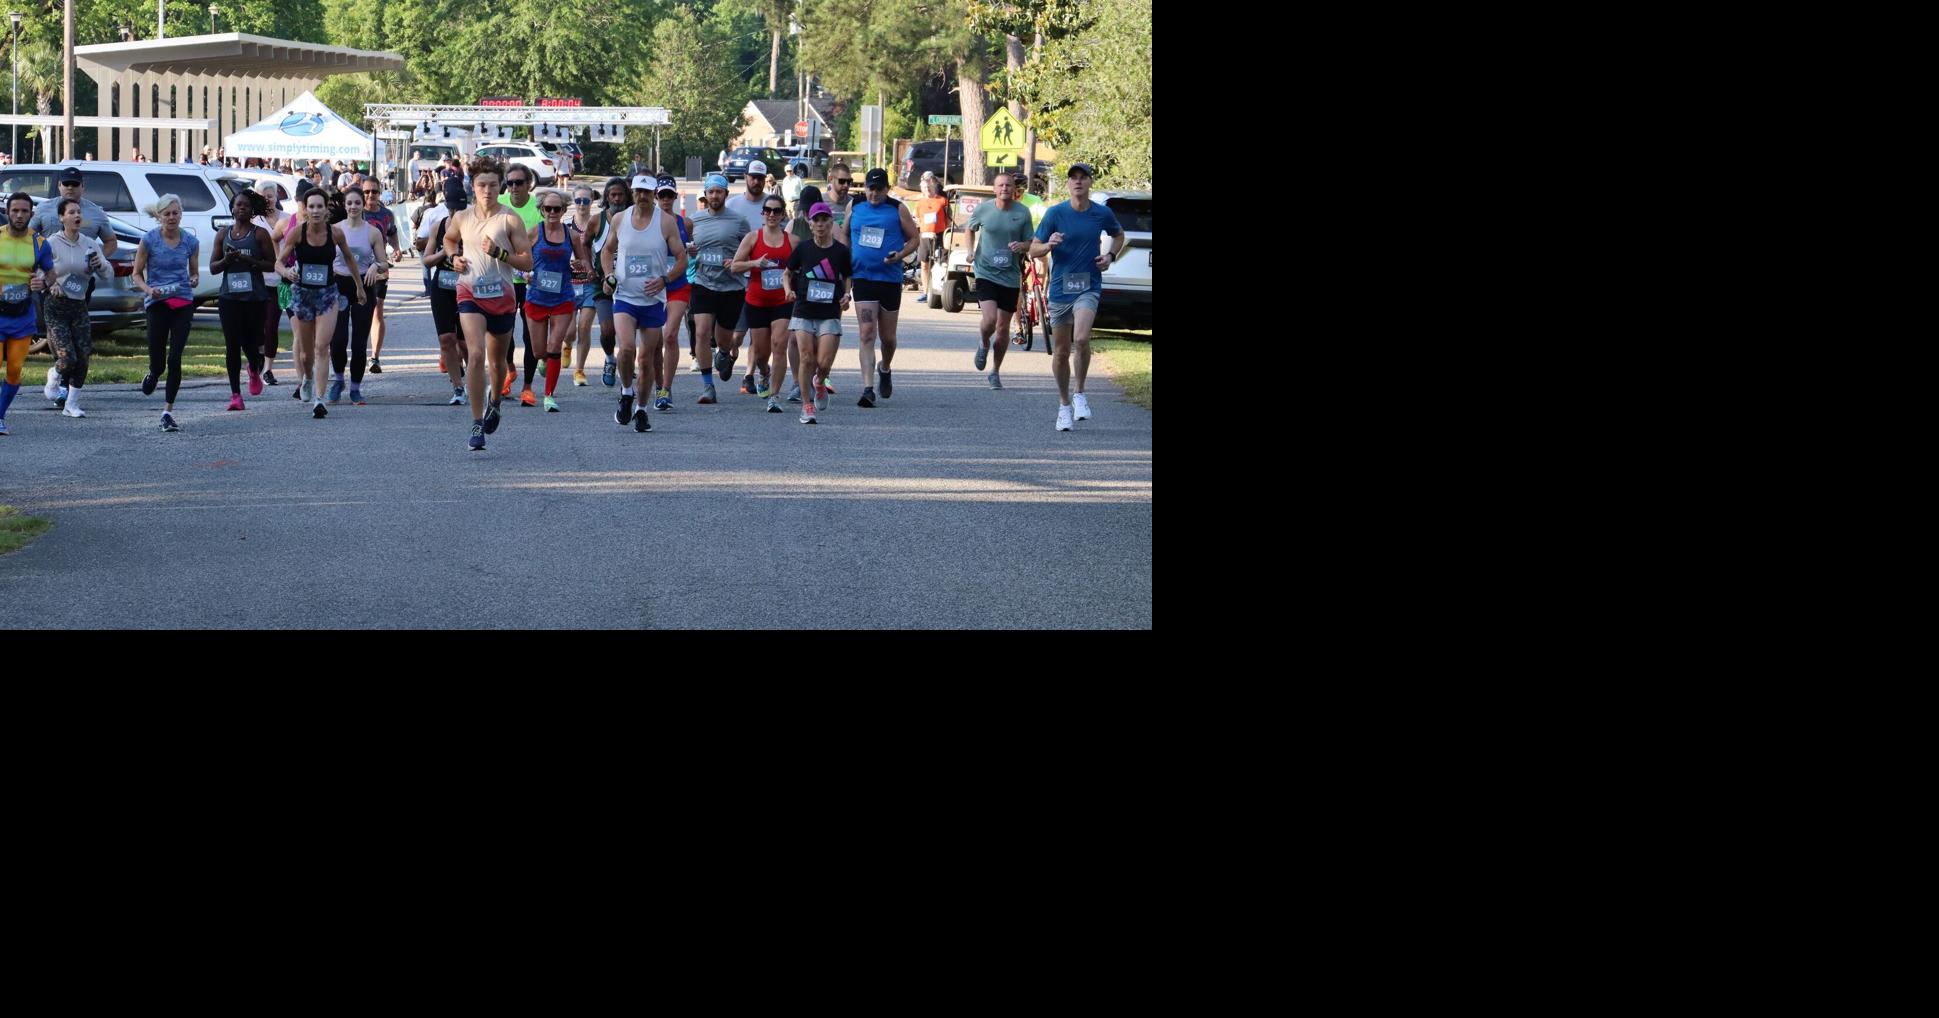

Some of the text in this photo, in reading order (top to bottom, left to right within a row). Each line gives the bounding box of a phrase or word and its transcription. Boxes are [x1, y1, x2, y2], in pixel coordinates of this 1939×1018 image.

[238, 142, 360, 156] www.simplytiming.com
[702, 253, 721, 262] 1211
[993, 256, 1009, 264] 999
[629, 264, 648, 273] 925
[306, 272, 324, 281] 932
[66, 280, 82, 292] 989
[231, 280, 248, 289] 982
[540, 279, 558, 288] 927
[1067, 281, 1085, 289] 941
[475, 284, 502, 294] 1194
[809, 288, 833, 298] 1207
